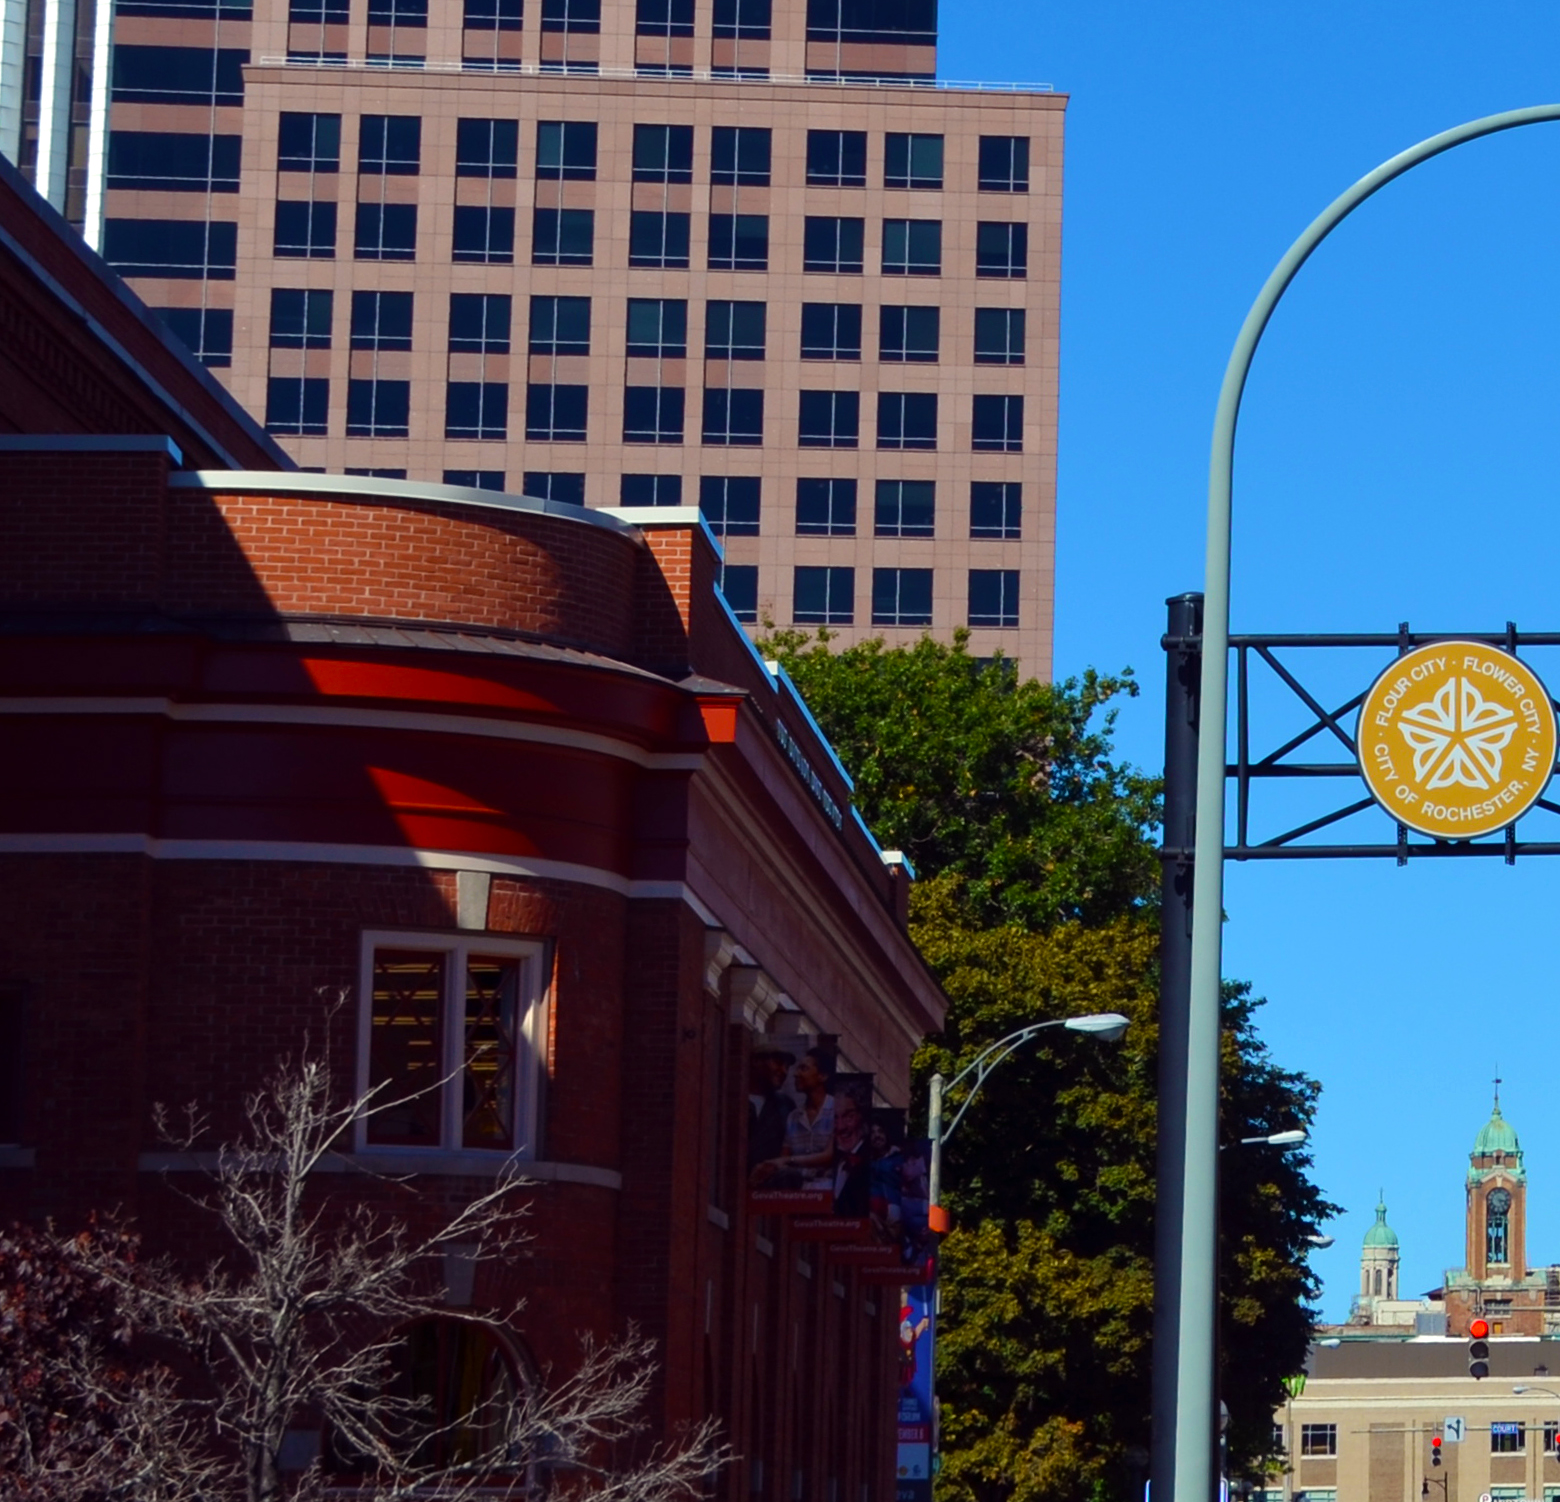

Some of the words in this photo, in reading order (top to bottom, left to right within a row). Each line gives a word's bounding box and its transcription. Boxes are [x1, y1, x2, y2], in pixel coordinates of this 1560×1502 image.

[1375, 676, 1412, 727] FLOUR
[1410, 657, 1446, 681] CITY
[1462, 656, 1526, 699] FLOWER
[1519, 698, 1541, 734] CITY
[1374, 743, 1399, 782] CITY
[1395, 785, 1419, 805] OF
[1421, 780, 1530, 821] ROCHESTER,
[1521, 747, 1540, 772] NY
[752, 1191, 823, 1202] GevaTheatre.org
[794, 1219, 861, 1229] GevaTheatre.org
[1493, 1424, 1515, 1433] COURT
